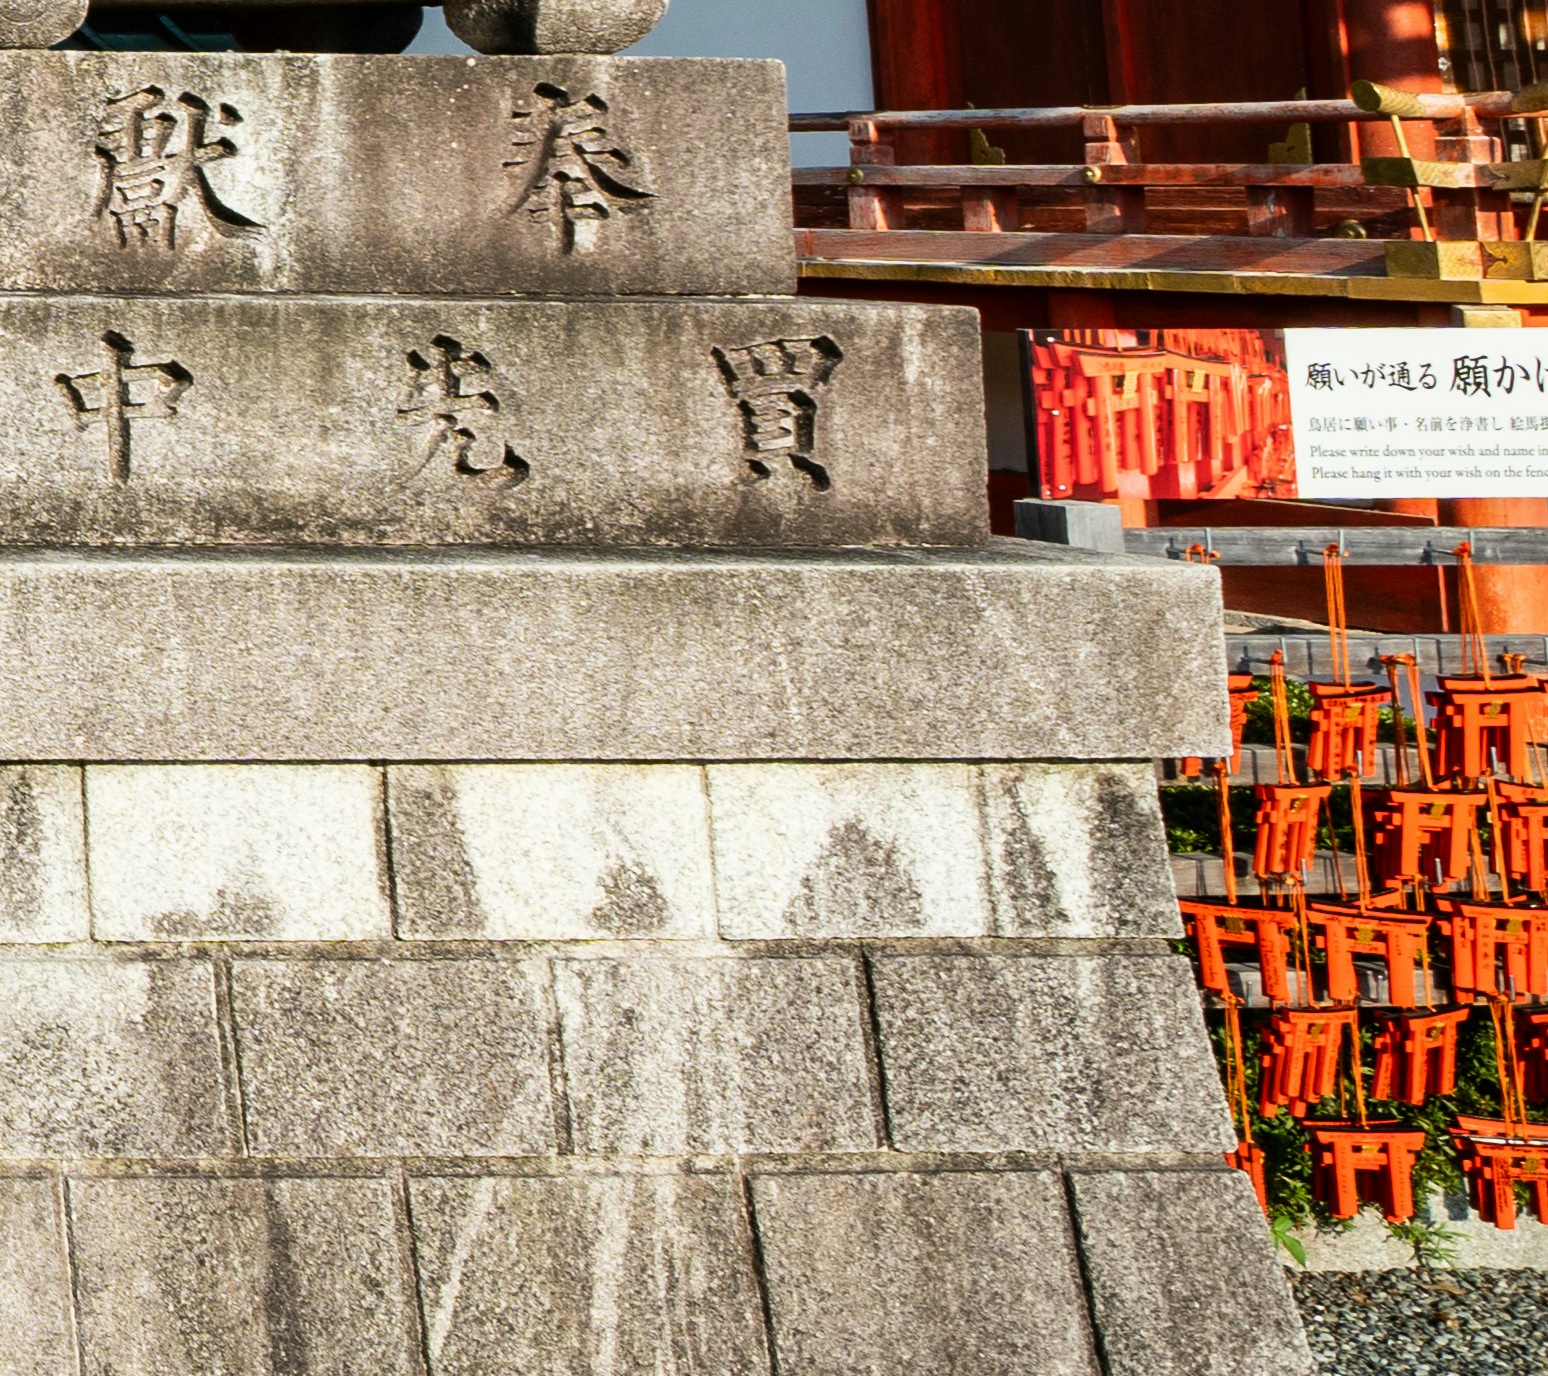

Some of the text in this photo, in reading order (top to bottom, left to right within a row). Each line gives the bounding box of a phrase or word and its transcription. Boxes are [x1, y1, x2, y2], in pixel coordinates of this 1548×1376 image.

[1304, 362, 1438, 392] 願いが通る
[1310, 445, 1347, 458] Please
[1349, 445, 1380, 458] write
[1382, 444, 1416, 458] down
[1418, 448, 1446, 461] your
[1448, 444, 1475, 457] wish
[1478, 444, 1500, 457] and
[1503, 447, 1535, 457] name
[1312, 466, 1348, 479] Please
[1351, 466, 1381, 482] hang
[1384, 467, 1393, 479] it
[1396, 466, 1422, 479] with
[1425, 468, 1452, 482] your
[1455, 466, 1483, 479] wish
[1485, 468, 1501, 479] on
[1504, 465, 1522, 478] the
